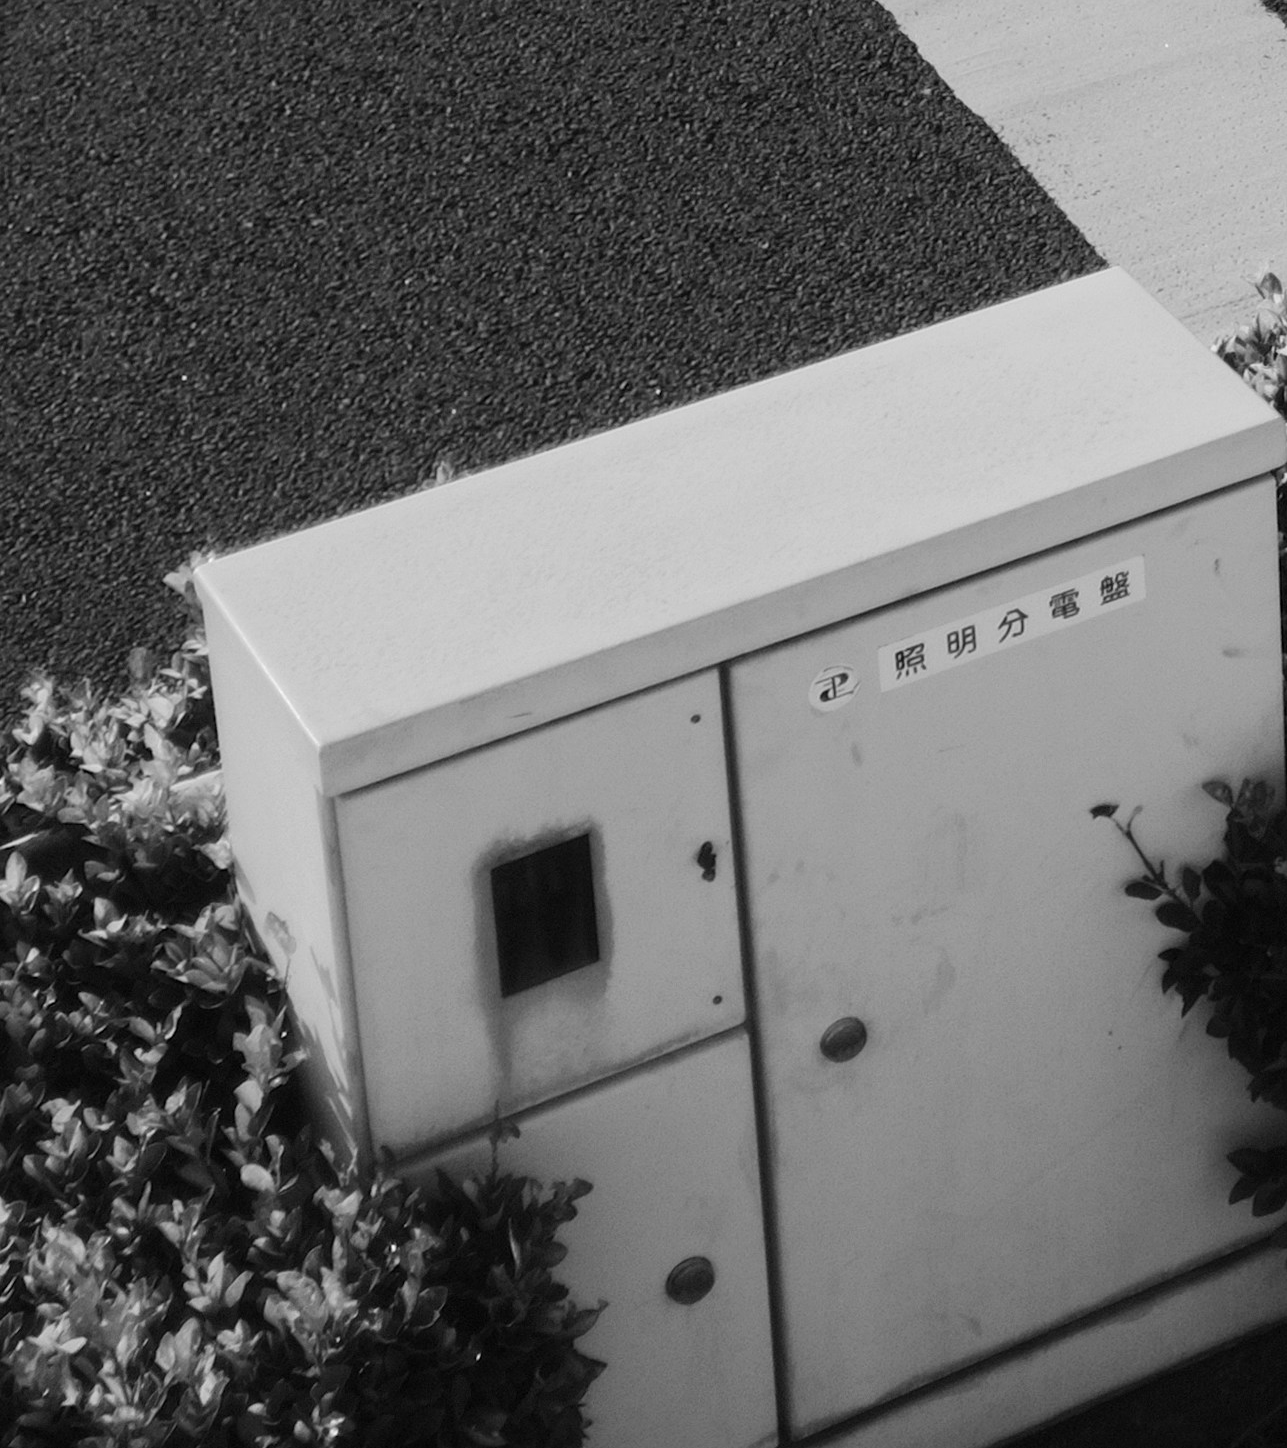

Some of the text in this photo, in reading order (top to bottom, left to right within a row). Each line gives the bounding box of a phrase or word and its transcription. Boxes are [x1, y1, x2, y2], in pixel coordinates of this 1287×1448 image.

[894, 570, 1130, 680] 照明分電盤
